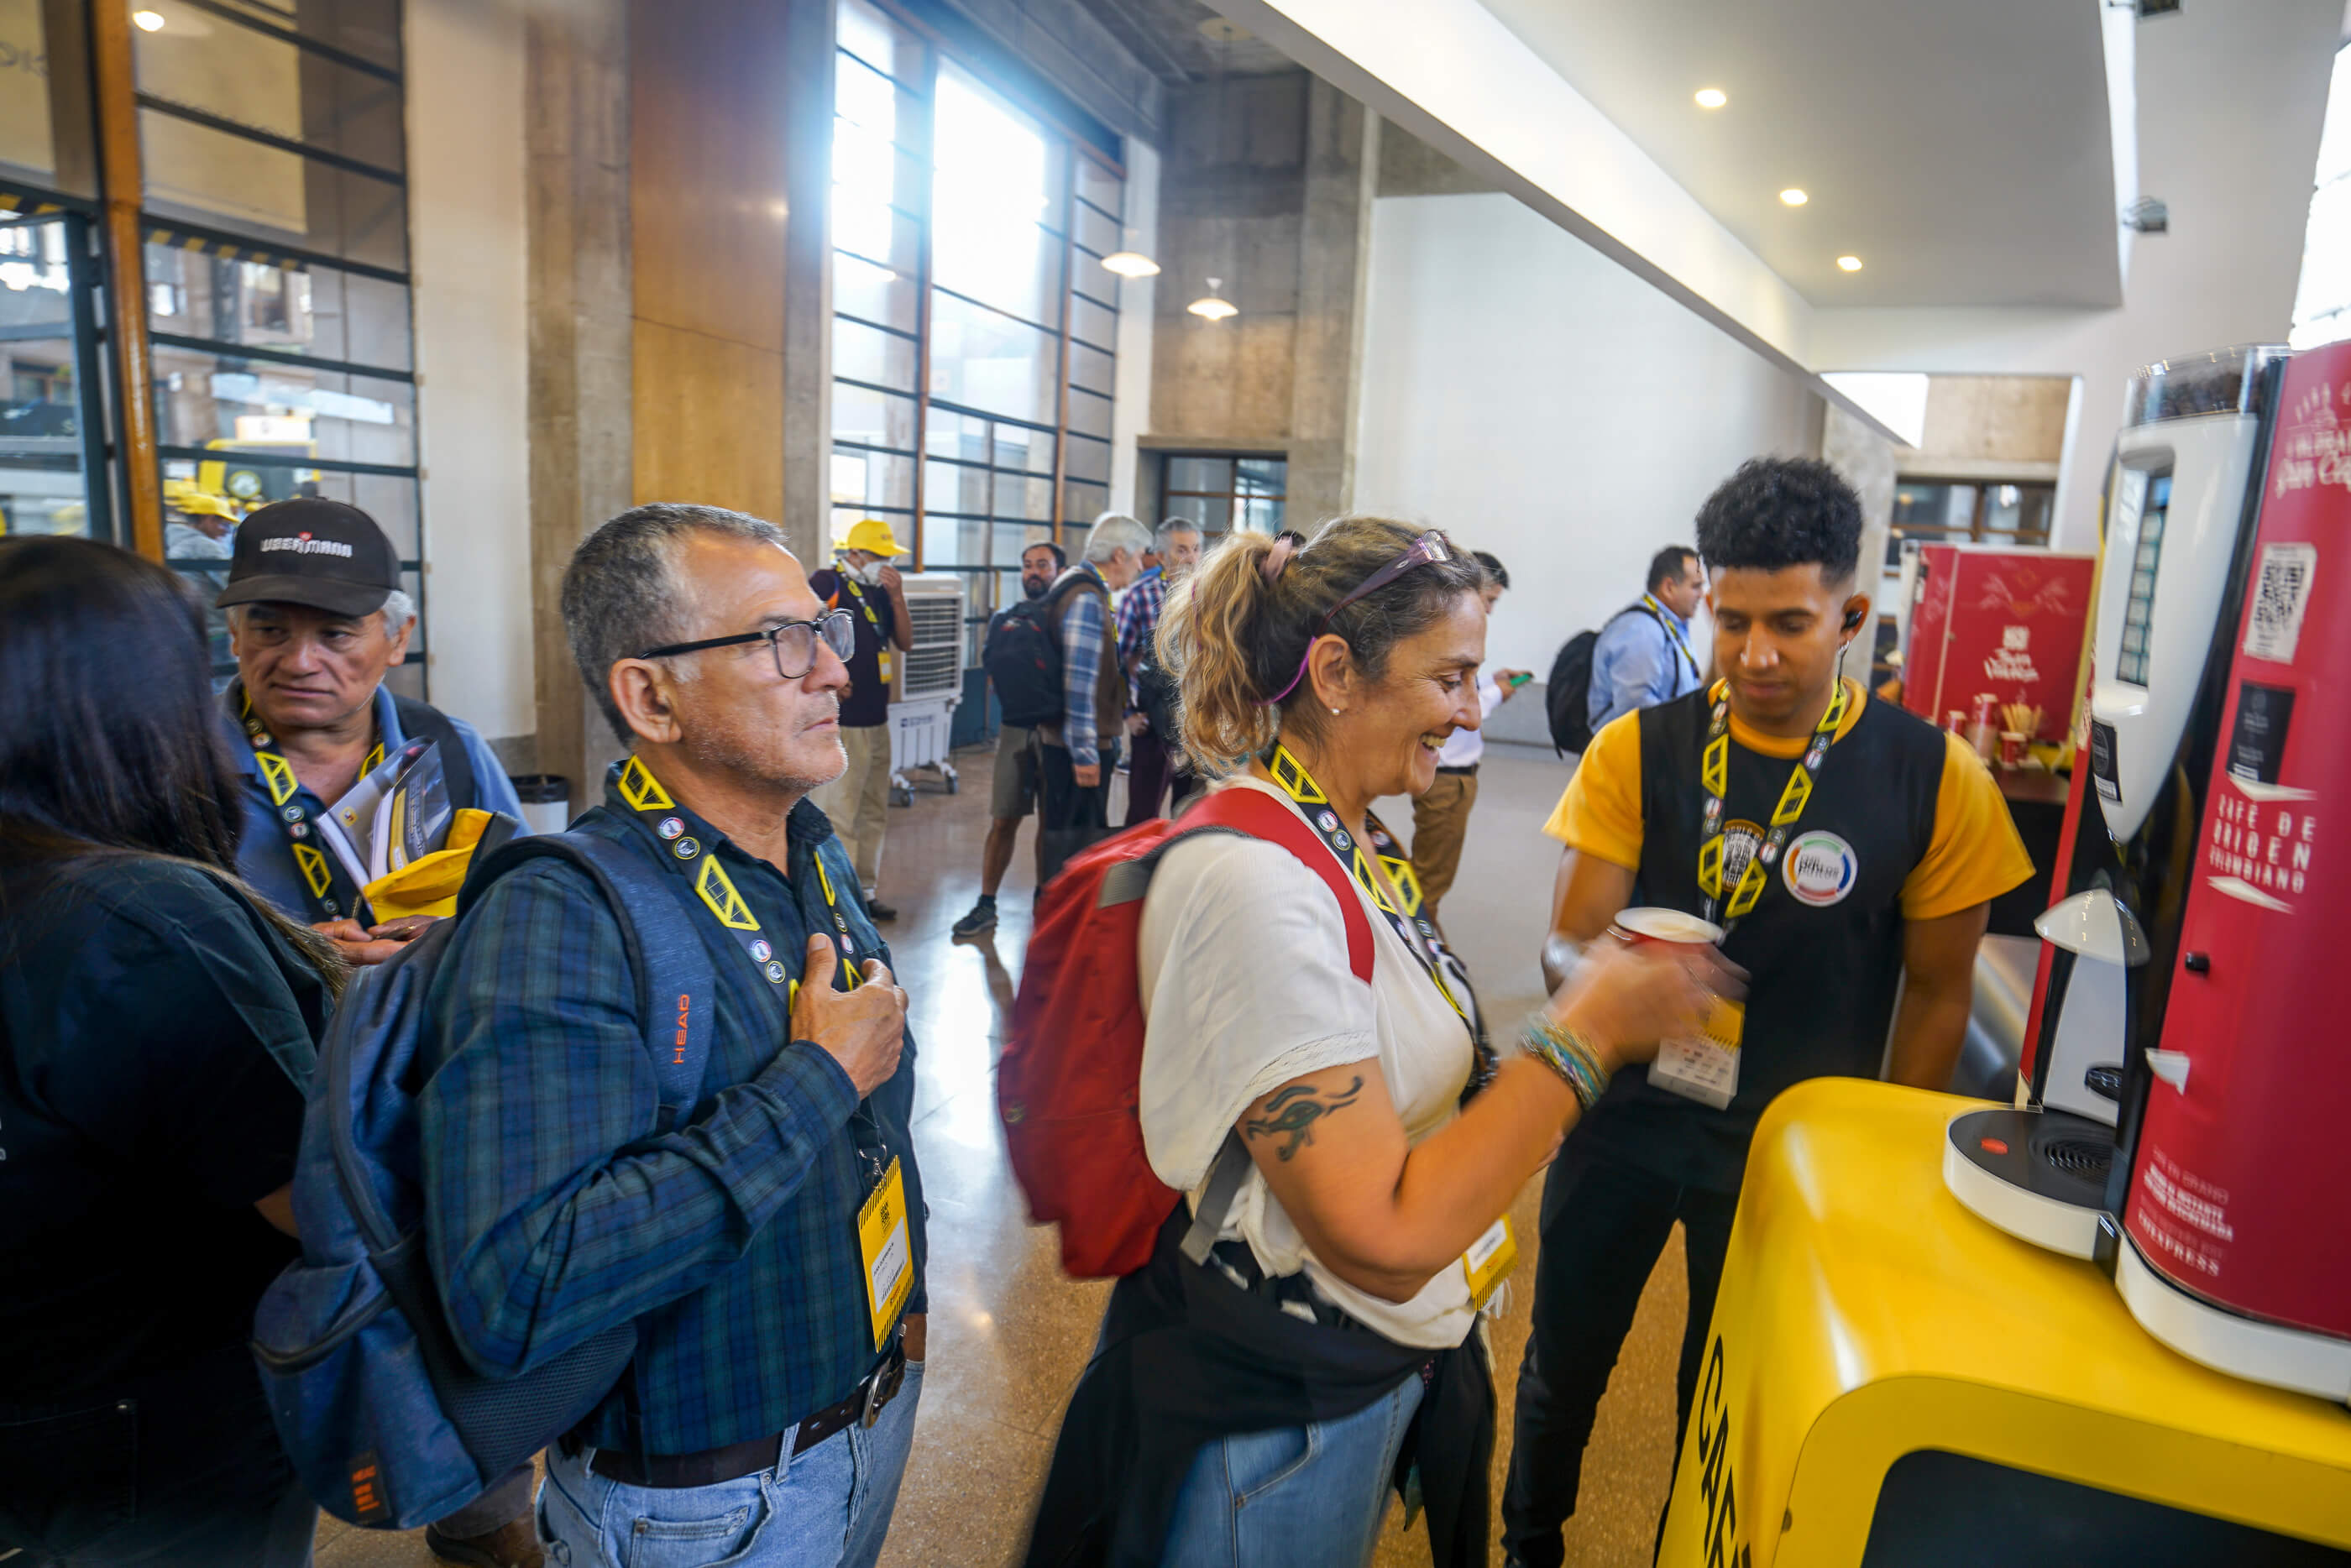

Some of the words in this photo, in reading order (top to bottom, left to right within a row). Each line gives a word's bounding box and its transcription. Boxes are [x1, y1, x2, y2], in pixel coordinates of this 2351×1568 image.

[2213, 818, 2311, 871] ORIGEN
[2277, 811, 2317, 842] DE
[2209, 844, 2305, 894] COLOMBIANO
[673, 994, 689, 1064] HEAD
